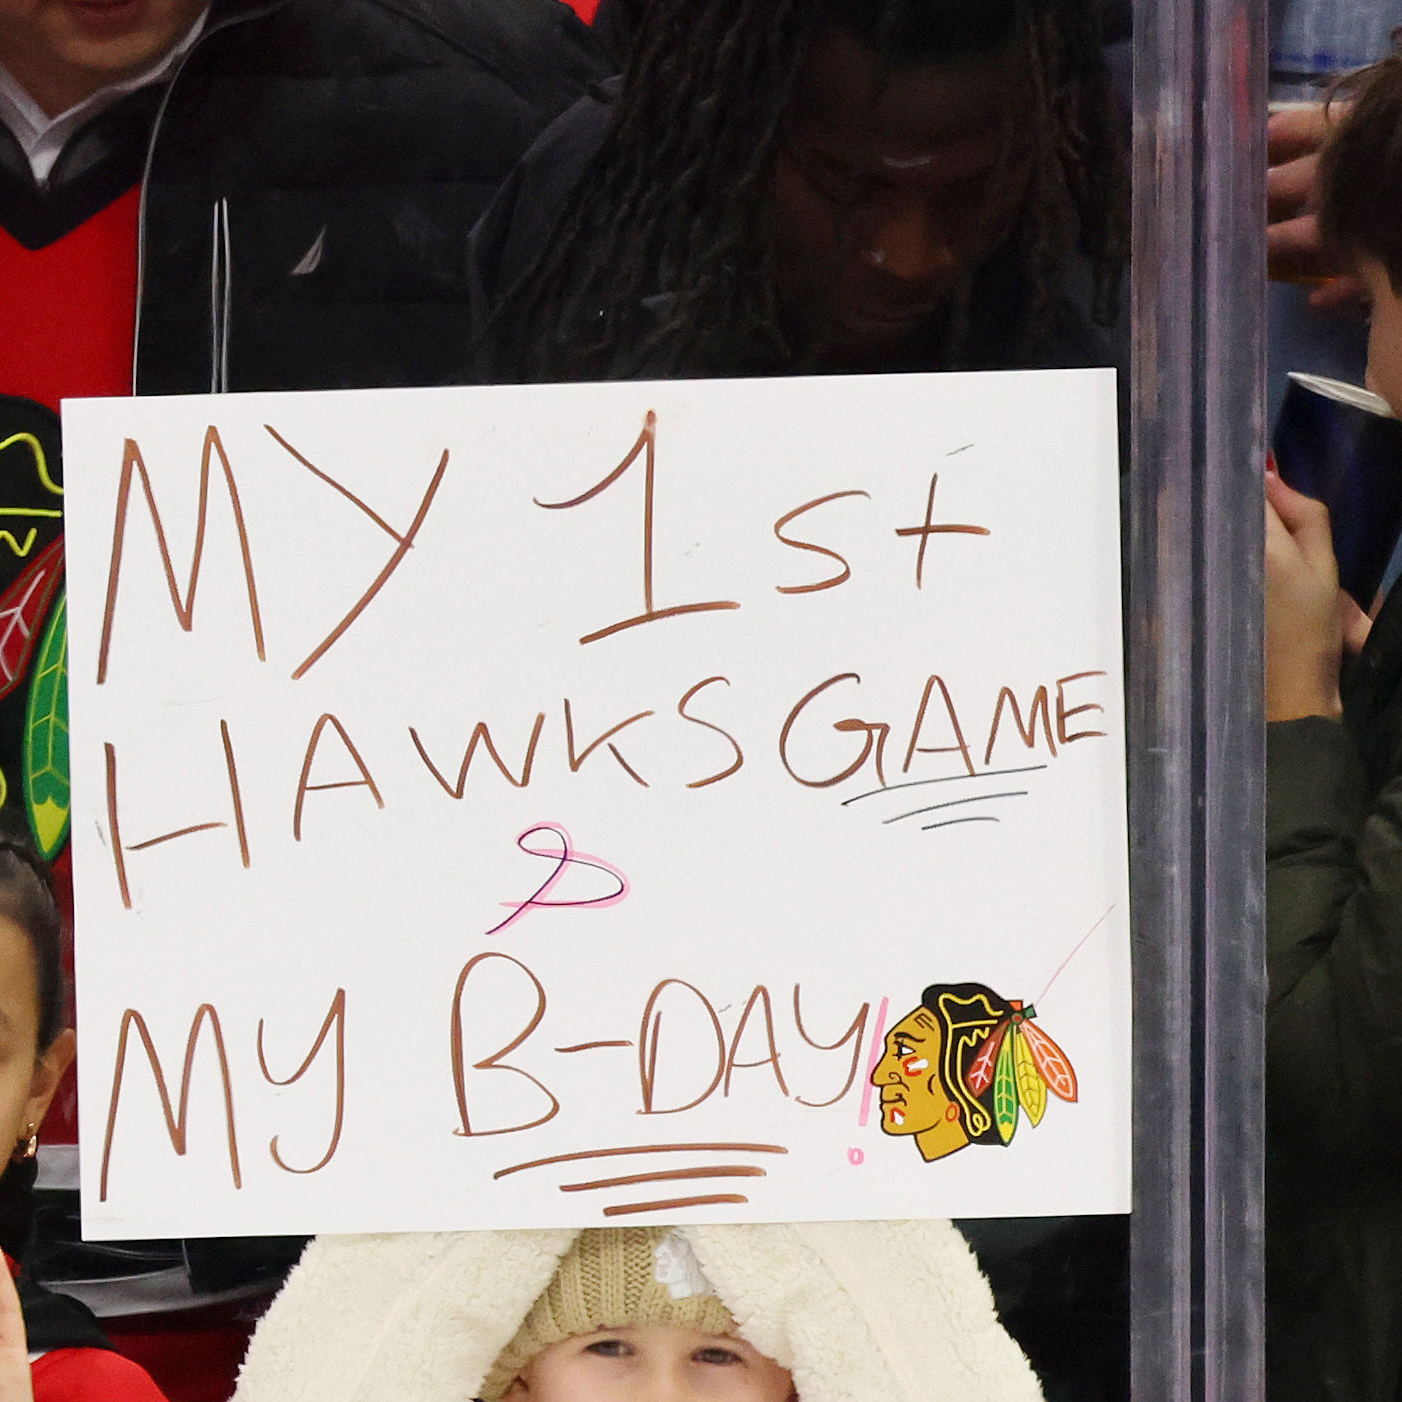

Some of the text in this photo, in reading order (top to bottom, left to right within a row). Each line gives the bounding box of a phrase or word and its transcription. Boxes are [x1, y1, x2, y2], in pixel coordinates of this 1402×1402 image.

[96, 423, 450, 686] MY
[104, 670, 1108, 910] HAWKS GAME
[99, 987, 346, 1203] MY
